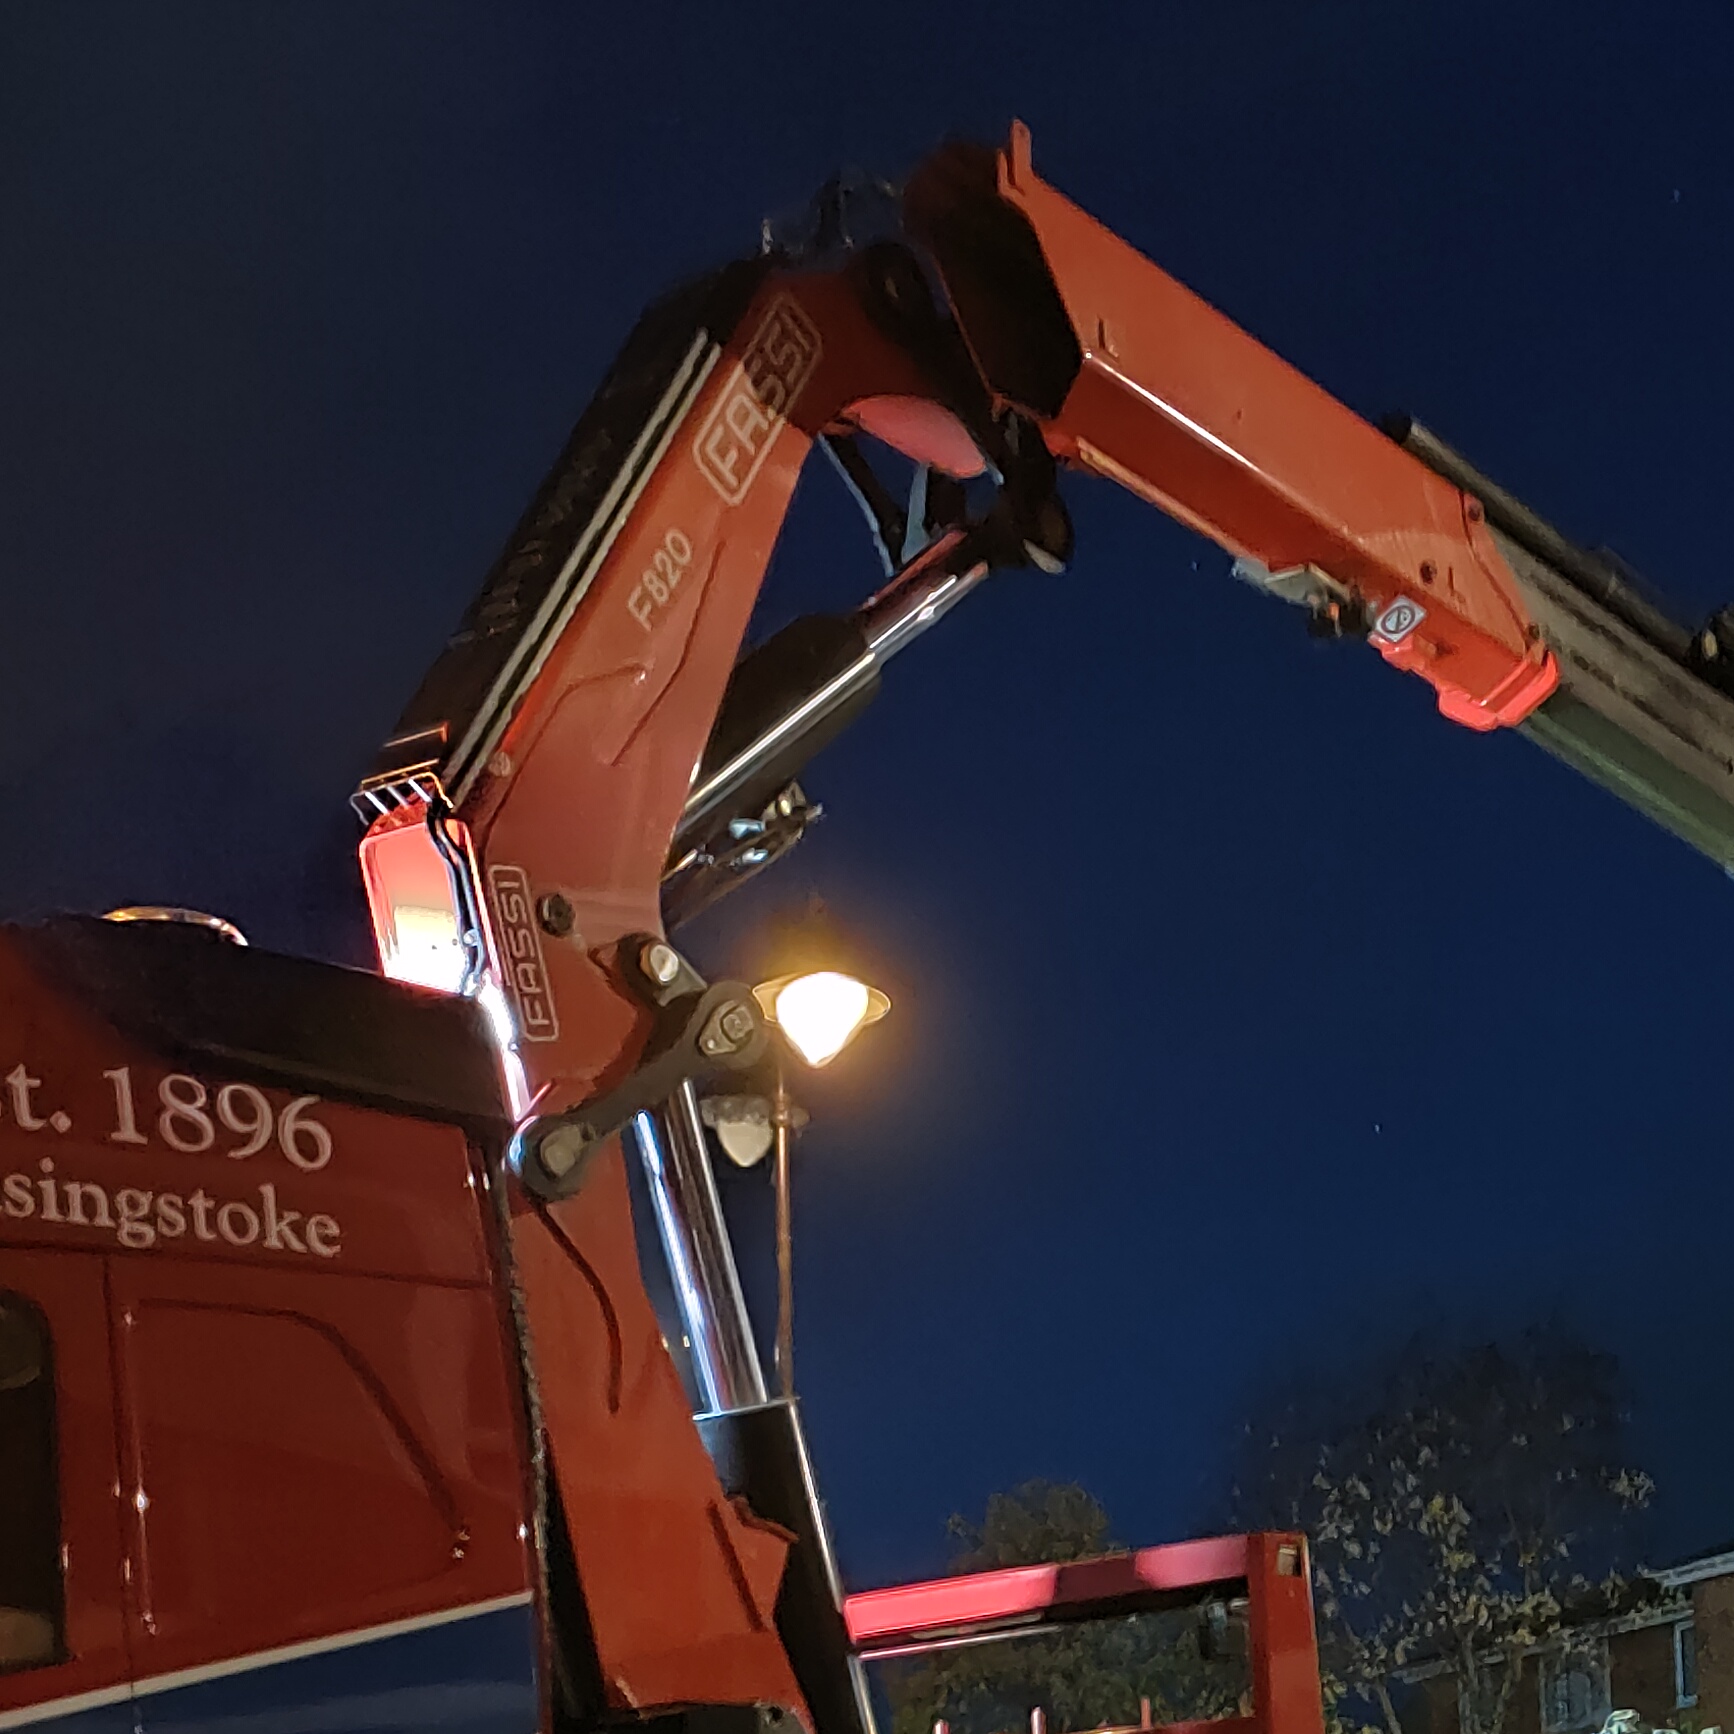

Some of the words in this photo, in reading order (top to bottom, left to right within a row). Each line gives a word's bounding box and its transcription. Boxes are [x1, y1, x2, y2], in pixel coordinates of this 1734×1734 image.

[704, 311, 812, 489] FASSI
[626, 528, 694, 631] F820
[497, 880, 552, 1026] FASSI
[0, 1063, 73, 1134] t.
[102, 1066, 333, 1171] 1896
[0, 1156, 343, 1258] singstoke
